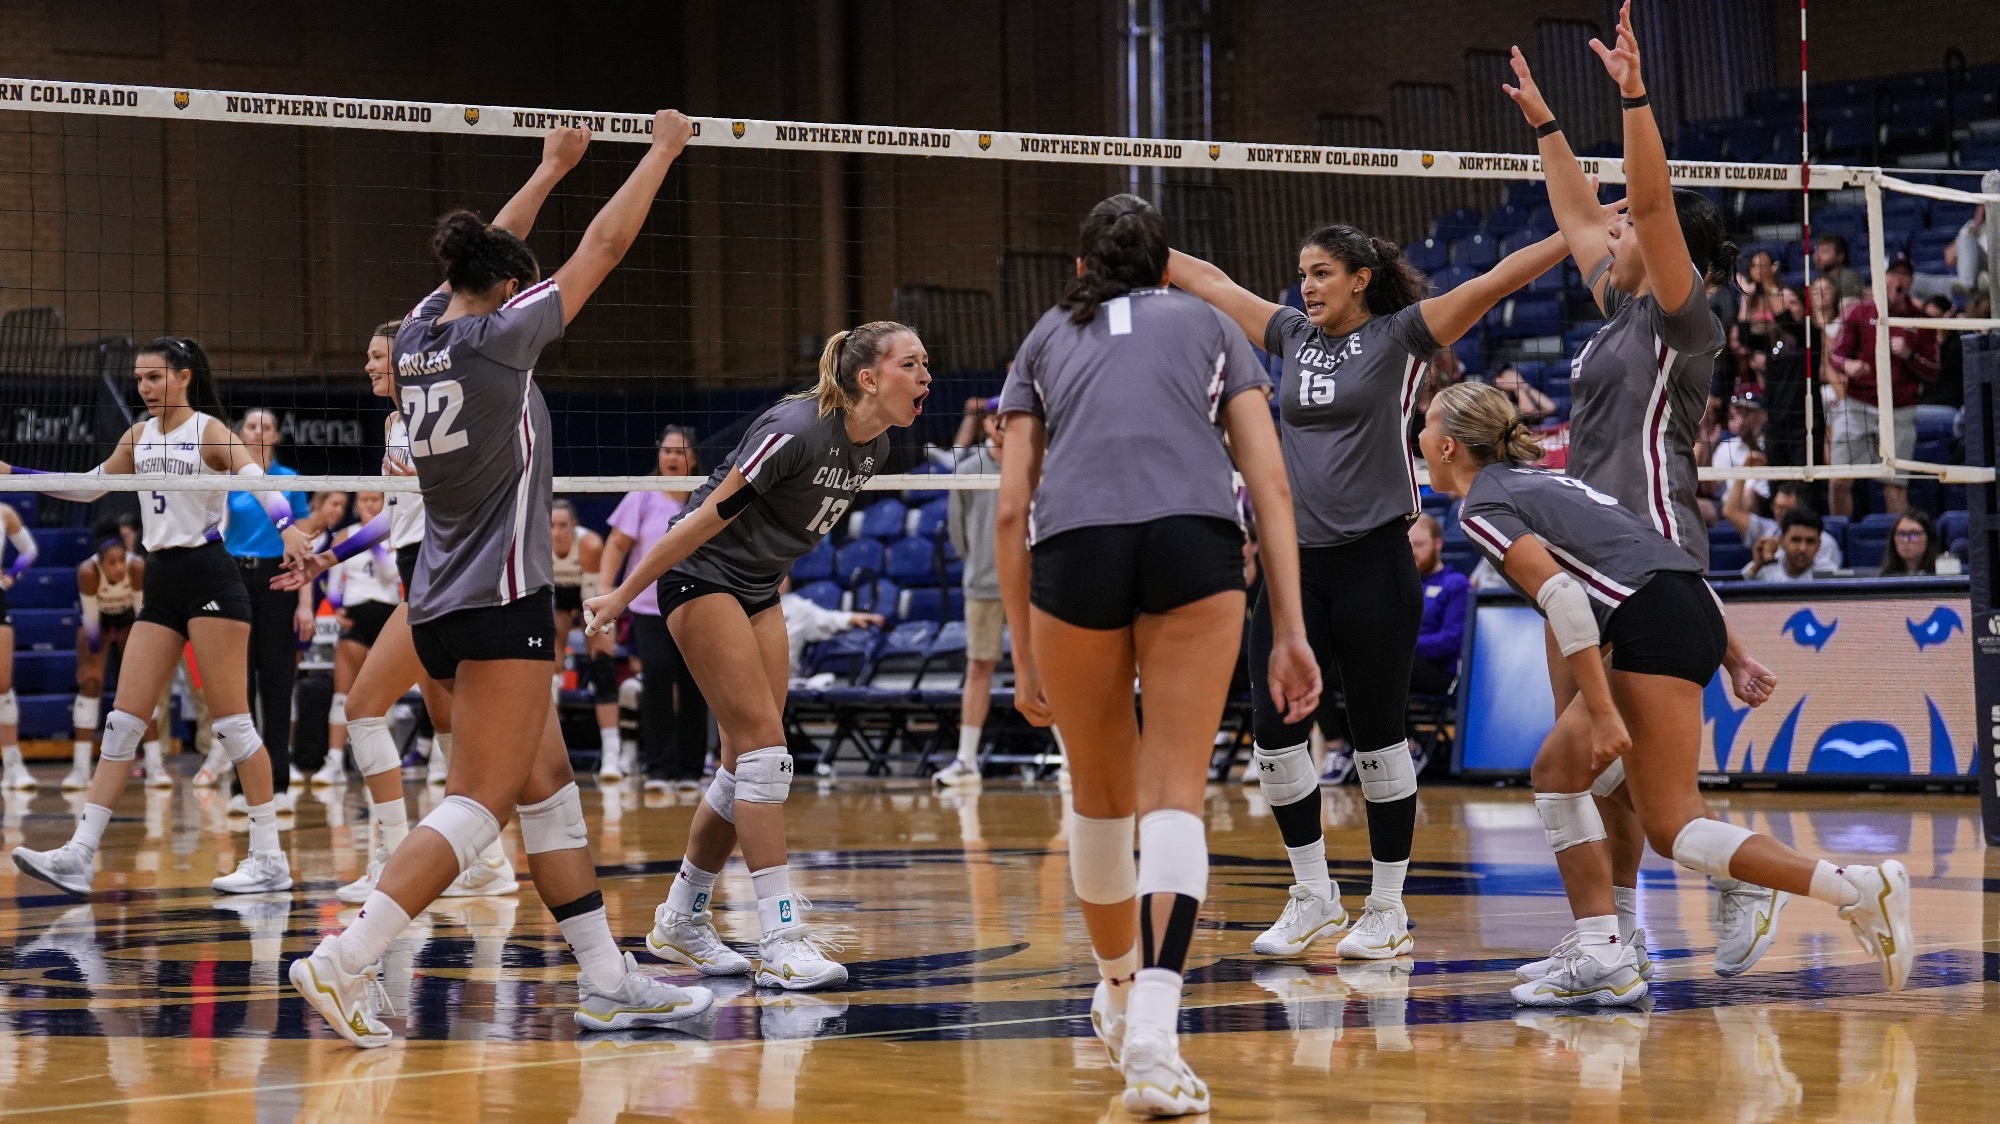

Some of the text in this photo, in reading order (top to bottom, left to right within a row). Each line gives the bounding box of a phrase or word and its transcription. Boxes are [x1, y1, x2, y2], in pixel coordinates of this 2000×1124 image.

[30, 86, 138, 107] COLORADO
[226, 96, 432, 123] NORTHERN COLORADO
[610, 117, 701, 137] COLOO
[775, 126, 951, 148] NORTHERN COLORADO
[1020, 138, 1182, 159] NORTHERN COLORADO
[1246, 148, 1399, 168] NORTHERN COLORADO
[1459, 156, 1528, 172] NORTHERN
[1725, 167, 1788, 181] COLORADO
[1299, 370, 1337, 406] 15
[281, 411, 363, 446] Arena
[401, 380, 469, 458] 22
[136, 457, 194, 476] WASHINGTON
[805, 496, 850, 535] 13
